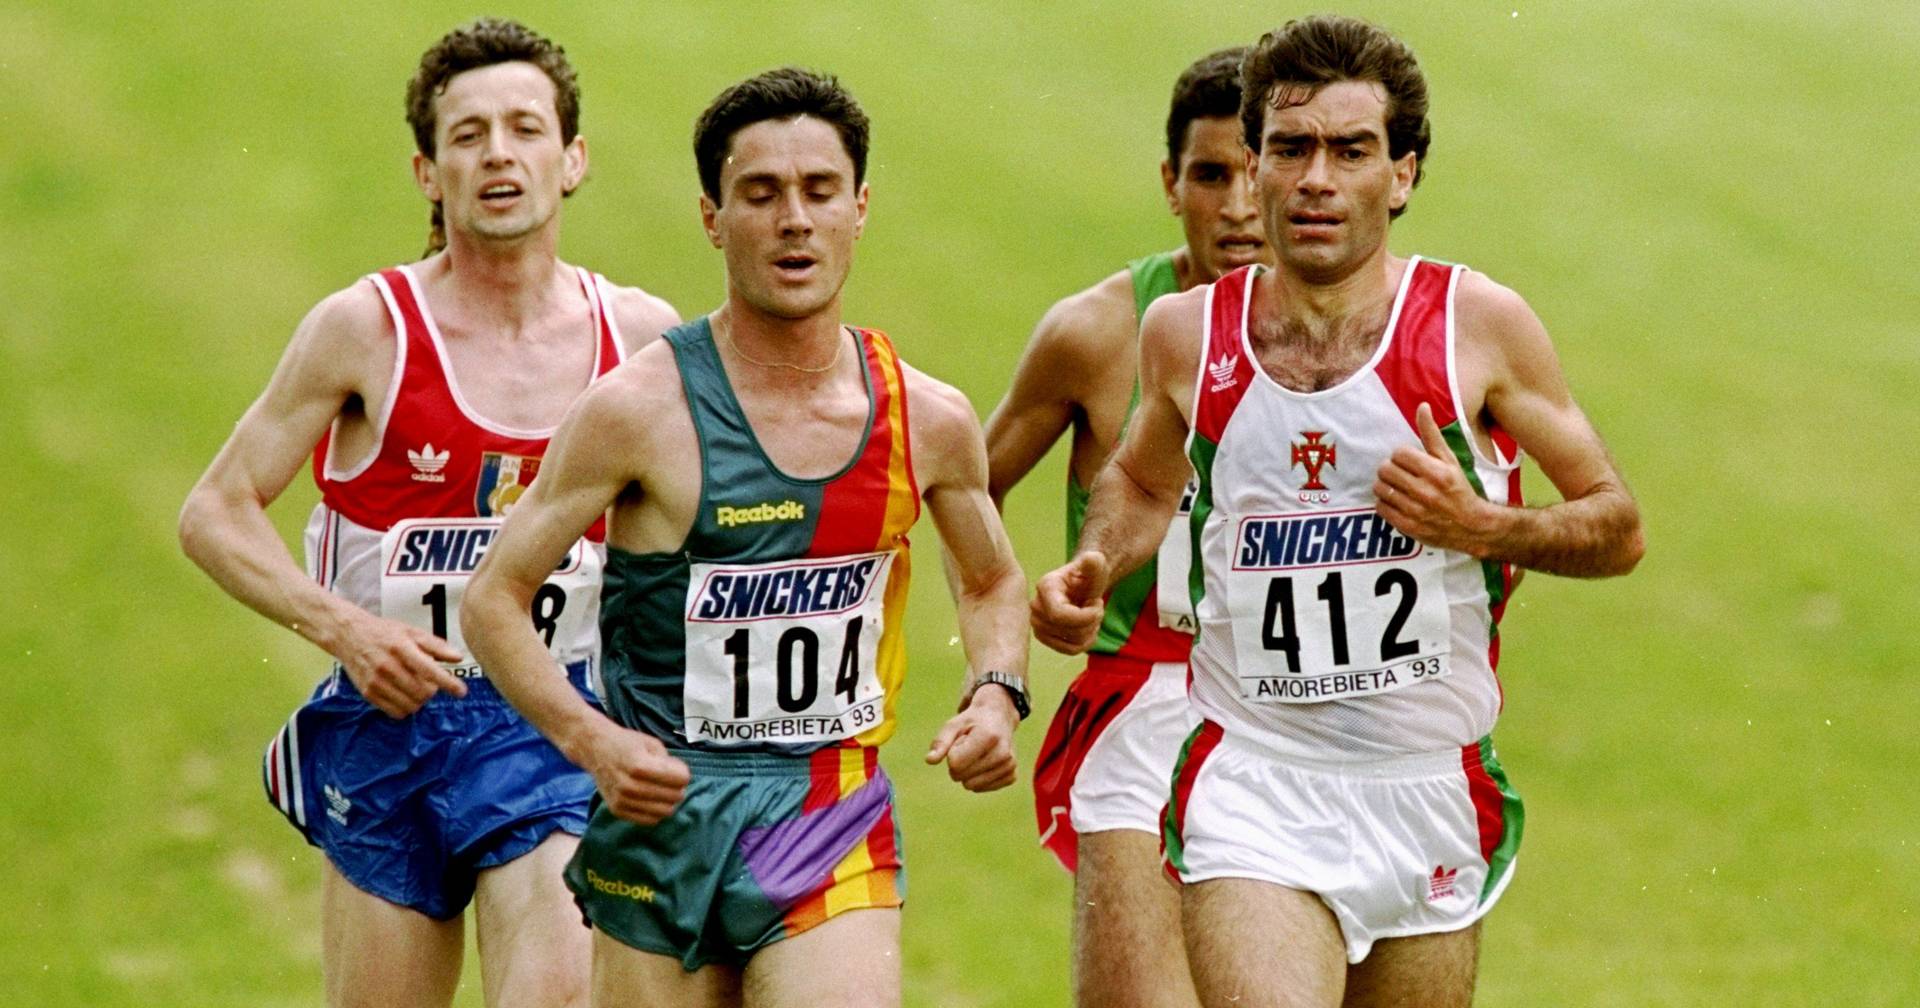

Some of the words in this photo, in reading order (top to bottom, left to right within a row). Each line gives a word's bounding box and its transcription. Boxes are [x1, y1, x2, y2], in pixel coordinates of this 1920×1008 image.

[411, 473, 446, 483] adidas
[485, 456, 539, 473] FRANCE
[717, 501, 805, 526] Reebok
[698, 559, 876, 620] SNICKERS
[422, 583, 567, 650] 18
[1261, 568, 1420, 674] 412
[724, 615, 864, 720] 104
[1257, 670, 1398, 698] AMOREBIETA
[699, 718, 845, 741] AMOREBIETA
[586, 868, 656, 903] Reebok
